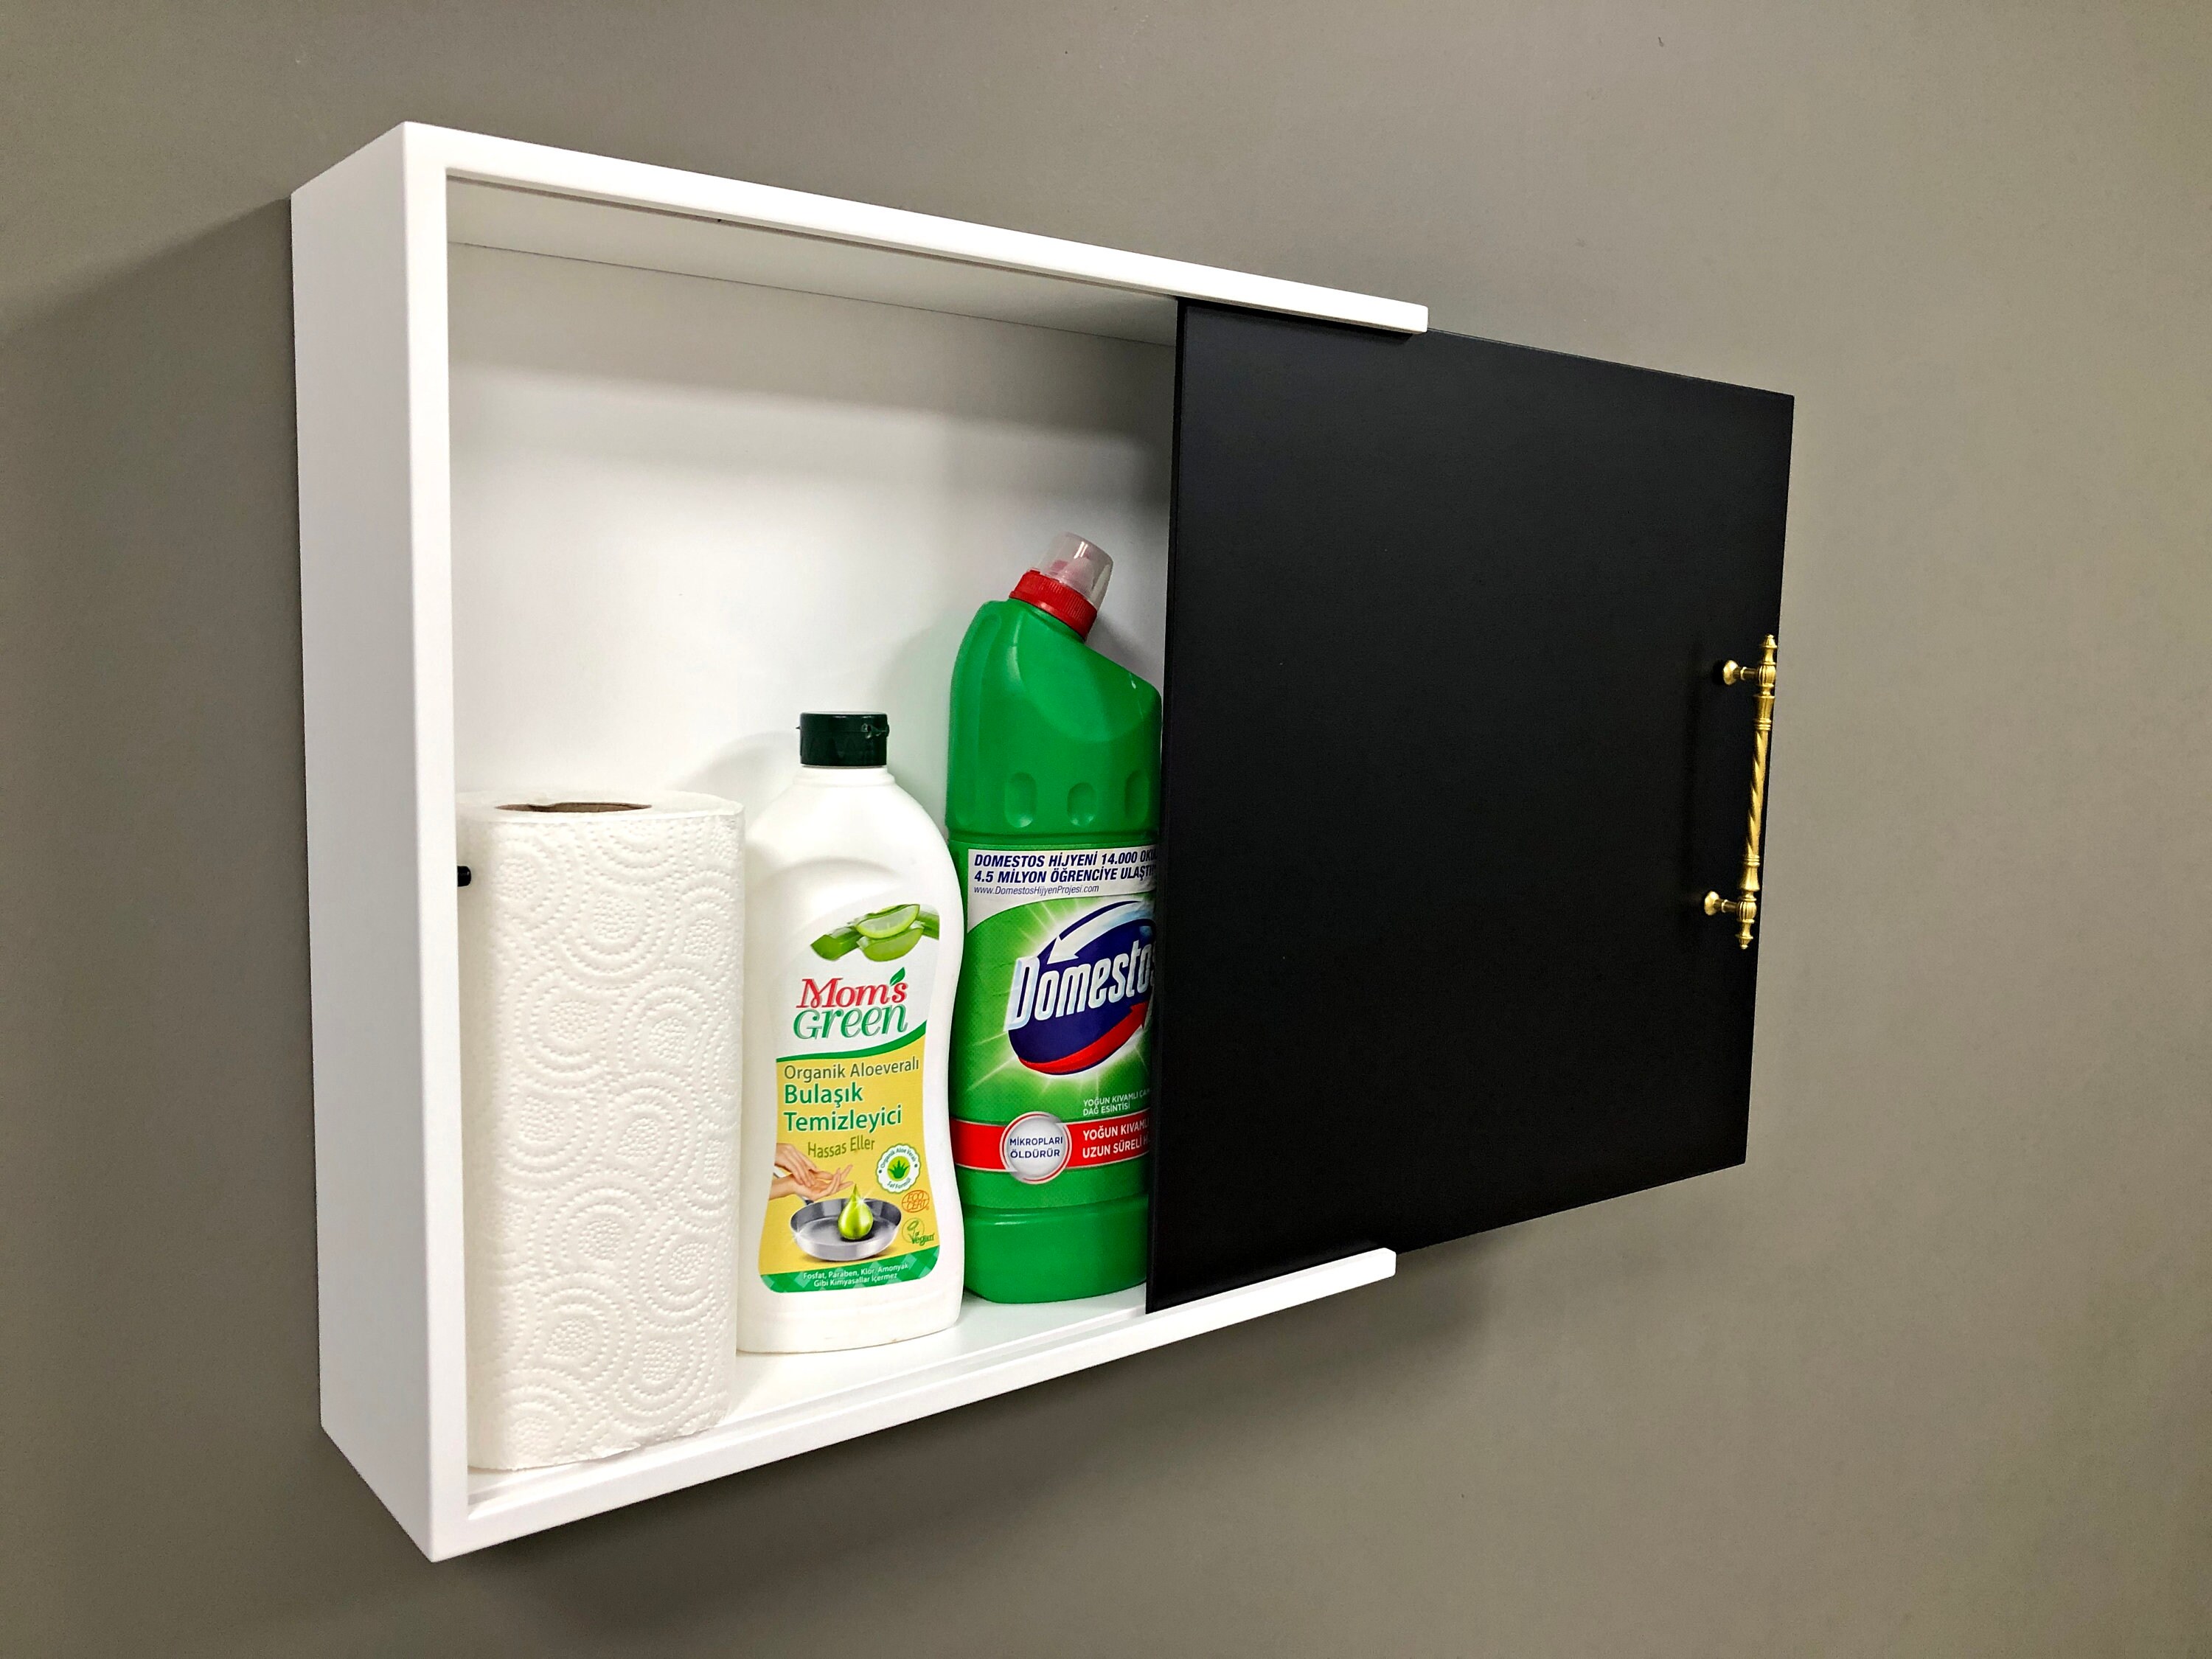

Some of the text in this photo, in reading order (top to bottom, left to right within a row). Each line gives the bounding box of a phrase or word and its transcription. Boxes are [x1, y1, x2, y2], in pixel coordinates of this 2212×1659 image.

[974, 854, 1046, 868] DOMESTOS
[1048, 851, 1099, 867] HİJYENİ
[1102, 851, 1138, 865] 14.000
[974, 870, 994, 883] 4.5
[997, 868, 1047, 883] MİLYON
[1050, 866, 1119, 883] ÖĞRENCİYE
[973, 885, 1099, 897] www.DomestosHijyenProjesi.com
[796, 967, 908, 1009] Mom's
[793, 1004, 908, 1040] Green
[784, 1056, 919, 1082] Organik Aloeveralı
[785, 1082, 863, 1107] Bulaşık
[1083, 1096, 1110, 1107] YOĞUN
[1112, 1091, 1138, 1103] KIVAMLI
[1083, 1101, 1130, 1116] DAĞ ESİNTİSİ
[783, 1105, 902, 1133] Temizleyici
[1009, 1136, 1063, 1146] MİKROPLARI
[1082, 1125, 1119, 1141] YOĞUN
[807, 1135, 875, 1158] Hassas Eller
[1010, 1148, 1060, 1158] ÖLDÜRÜR
[1082, 1144, 1110, 1158] UZUN
[1113, 1134, 1142, 1154] SÜRELİ
[813, 1279, 829, 1287] Gibi
[830, 1276, 870, 1287] Kimyasallar
[828, 1270, 860, 1278] Paraben,
